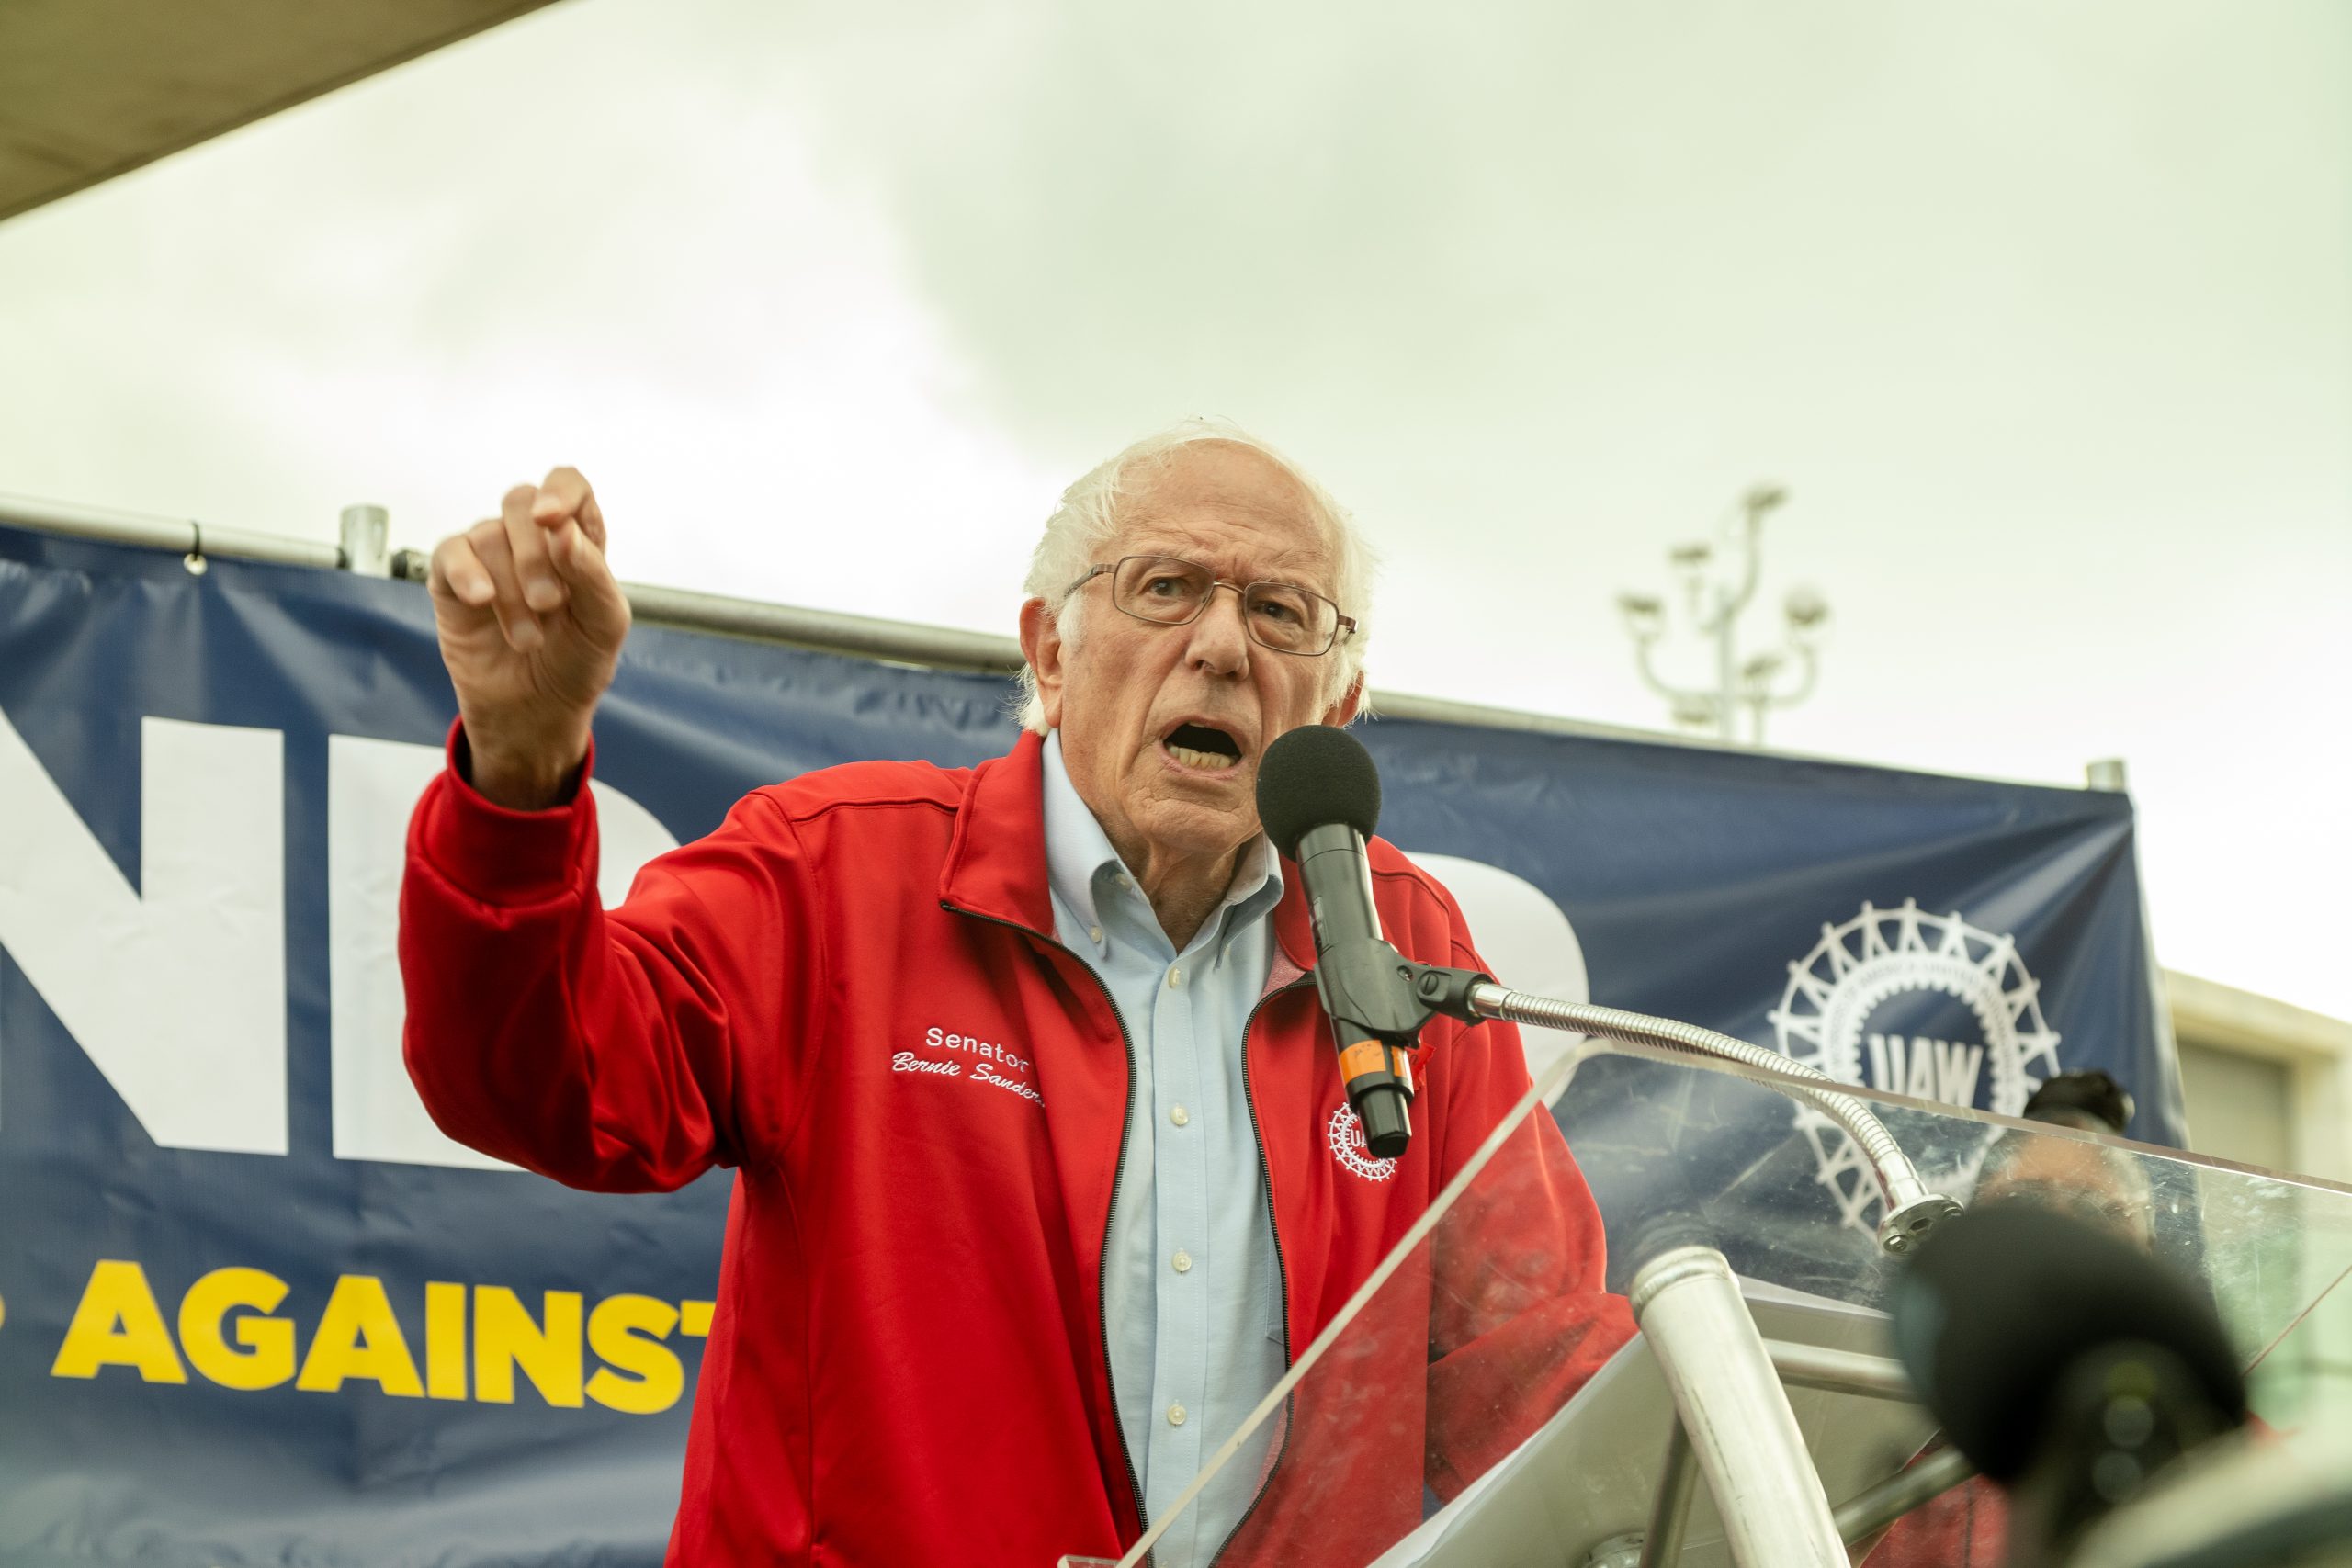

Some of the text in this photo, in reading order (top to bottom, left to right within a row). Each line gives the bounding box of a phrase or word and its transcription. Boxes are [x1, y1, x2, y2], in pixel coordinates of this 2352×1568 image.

[892, 1052, 961, 1076] Bernie
[926, 1027, 1029, 1073] Senator
[1868, 1032, 1984, 1109] UAW
